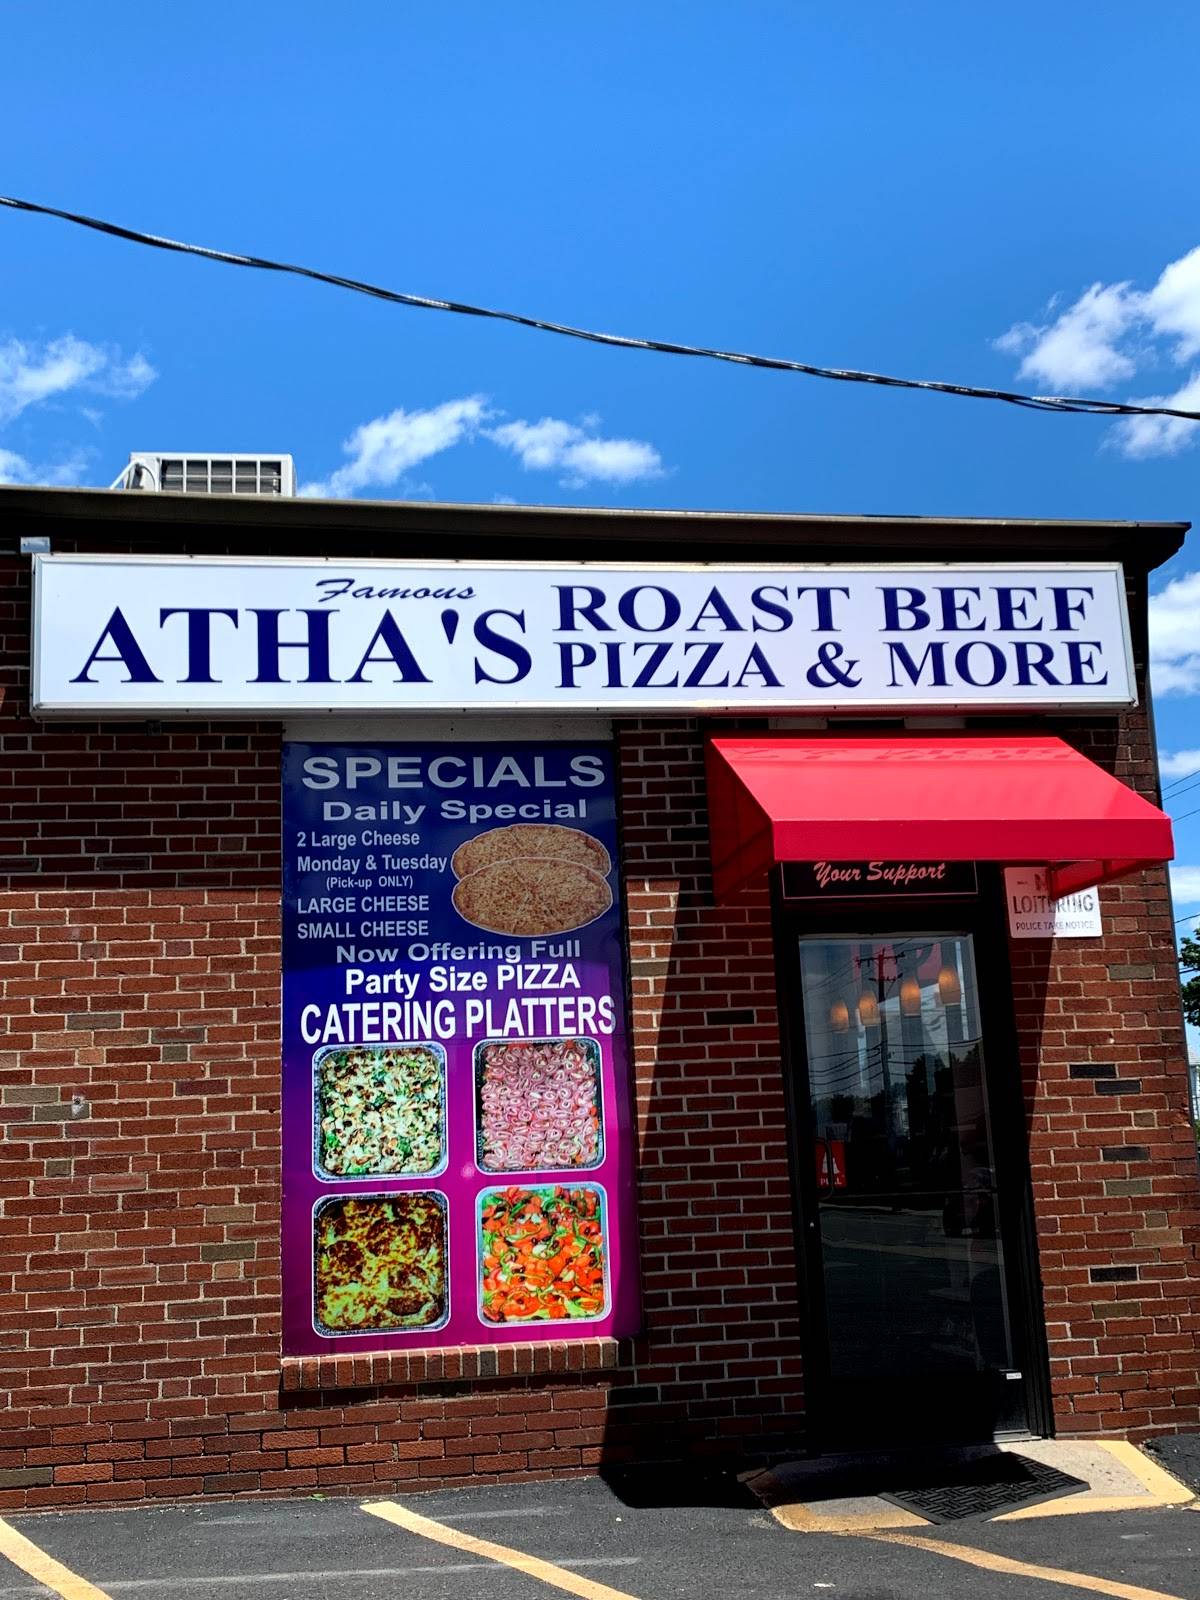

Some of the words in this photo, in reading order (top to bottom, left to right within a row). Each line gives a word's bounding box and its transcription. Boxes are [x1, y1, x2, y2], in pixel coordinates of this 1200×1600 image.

[315, 578, 476, 602] Famous
[550, 585, 849, 632] ROAST
[875, 587, 1094, 632] BEEF
[69, 606, 532, 684] ATHA'S
[553, 641, 784, 688] PIZZA
[806, 641, 863, 688] &
[883, 641, 1108, 686] MORE
[302, 755, 605, 789] SPECIALS
[323, 800, 426, 824] Daily
[440, 799, 587, 823] Special
[297, 832, 306, 847] 2
[311, 831, 357, 850] Large
[361, 830, 420, 846] Cheese
[297, 856, 360, 874] Monday
[365, 854, 377, 870] &
[382, 854, 448, 873] Tuesday
[813, 862, 861, 888] Your
[867, 861, 946, 885] Support
[326, 876, 373, 891] (Pick-up
[378, 875, 413, 889] ONLY)
[297, 897, 356, 914] LARGE
[361, 895, 429, 912] CHEESE
[297, 922, 356, 939] SMALL
[361, 920, 429, 937] CHEESE
[1016, 921, 1041, 930] POLICE
[1043, 921, 1064, 929] TAKE
[1065, 920, 1094, 929] NOTICE
[336, 945, 398, 963] Now
[408, 942, 521, 963] Offering
[531, 940, 581, 958] Full
[345, 968, 420, 999] Party
[429, 966, 488, 992] Size
[498, 963, 581, 990] PIZZA
[300, 999, 457, 1044] CATERING
[465, 995, 615, 1038] PLATTERS
